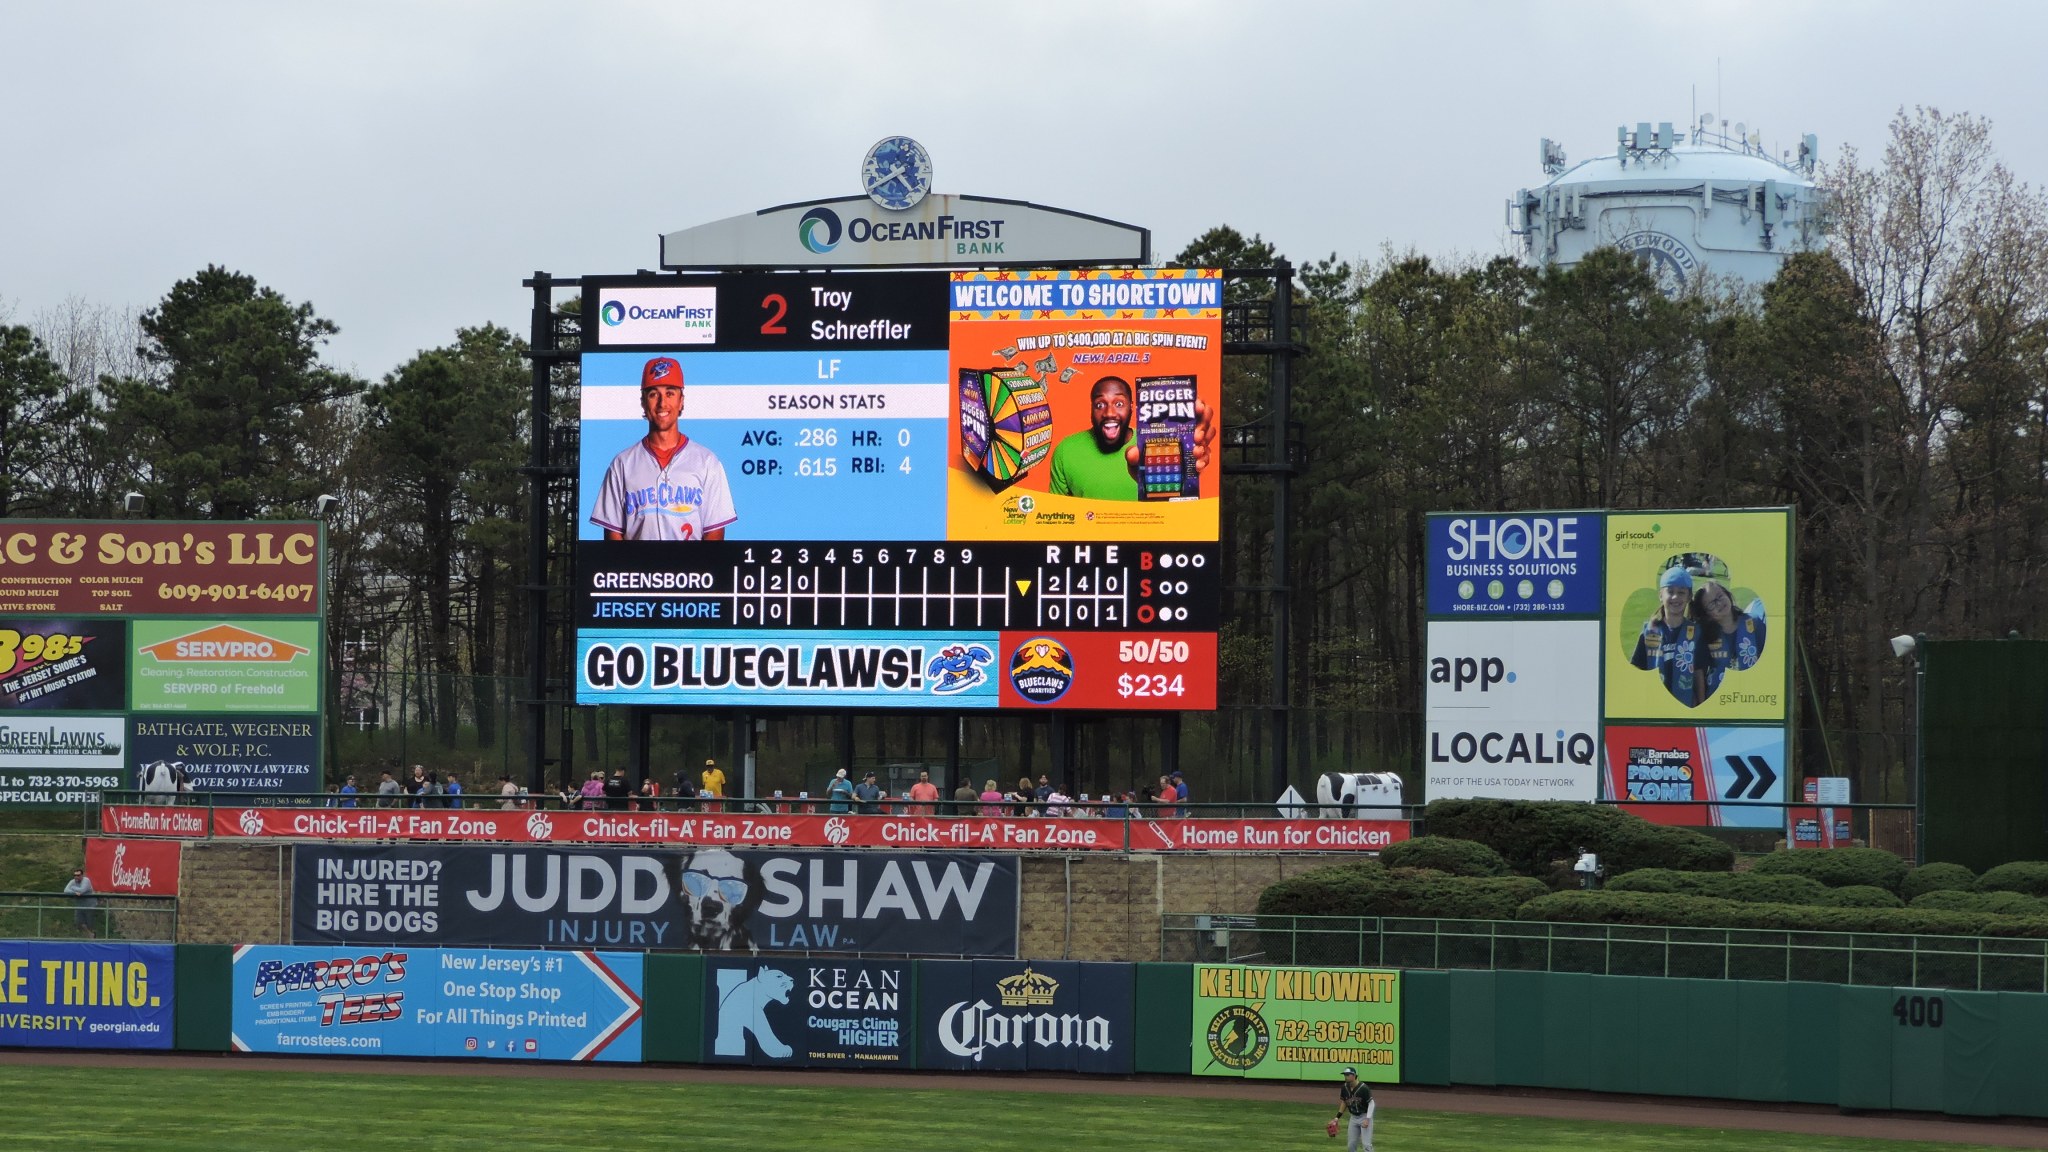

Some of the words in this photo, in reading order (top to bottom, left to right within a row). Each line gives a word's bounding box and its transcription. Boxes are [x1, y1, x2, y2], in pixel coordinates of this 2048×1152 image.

[848, 215, 1004, 243] OCEANFIRST
[957, 242, 1005, 254] BANK
[811, 287, 852, 311] Troy
[955, 283, 1052, 308] WELCOME
[1059, 284, 1085, 307] TO
[1089, 282, 1216, 307] SHORETOWN
[629, 305, 714, 320] OCEANFIRST
[811, 319, 911, 340] Schreffler
[1073, 353, 1104, 363] NEW!
[1106, 353, 1140, 363] APRIL
[1141, 353, 1150, 363] 3
[817, 358, 841, 379] LF
[767, 394, 835, 409] SEASON
[839, 394, 886, 409] STATS
[1139, 388, 1194, 402] BIGGER
[1138, 401, 1196, 423] $PIN
[741, 430, 783, 446] AVG:
[794, 428, 838, 447] .286
[851, 430, 882, 446] HR:
[897, 428, 910, 447] 0
[741, 459, 783, 476] OBP:
[794, 458, 837, 476] .615
[851, 457, 885, 474] RBI:
[899, 456, 912, 475] 4
[1003, 517, 1026, 526] Lottery
[1036, 511, 1075, 521] Anything
[1446, 517, 1578, 561] SHORE
[1615, 530, 1629, 541] girl
[1629, 531, 1655, 539] scouts
[1622, 541, 1630, 549] of
[1631, 541, 1643, 549] the
[1644, 541, 1668, 551] jersey
[1669, 541, 1690, 549] shore
[1140, 552, 1153, 570] B
[1446, 564, 1503, 577] BUSINESS
[1508, 562, 1577, 576] SOLUTIONS
[1, 577, 72, 585] CONSTRUCTION
[79, 576, 110, 584] COLOR
[112, 576, 144, 584] MULCH
[593, 572, 714, 588] GREENSBORO
[743, 575, 755, 590] 0
[770, 575, 782, 590] 2
[797, 575, 809, 590] 0
[1049, 576, 1060, 592] 2
[1077, 576, 1088, 592] 4
[1106, 576, 1118, 592] 0
[27, 589, 59, 597] MULCH
[158, 583, 314, 602] 609-901-6407
[592, 602, 657, 618] JERSEY
[661, 602, 721, 618] SHORE
[743, 603, 754, 618] 0
[770, 603, 781, 618] 0
[1048, 605, 1060, 621] 0
[1076, 605, 1088, 621] 0
[1106, 605, 1118, 621] 1
[1452, 603, 1505, 611] SHORE-BIZ.COM
[1513, 603, 1530, 612] (732)
[1532, 602, 1565, 611] 280-1333
[176, 641, 274, 658] SERVPRO
[1118, 638, 1190, 664] 50/50
[140, 667, 184, 679] Cleaning.
[186, 667, 244, 677] Restoration.
[246, 667, 309, 678] Construction.
[587, 645, 646, 688] GO
[653, 645, 924, 688] BLUECLAWS!
[1429, 657, 1517, 692] app.
[163, 683, 217, 694] SERVPRO
[220, 684, 232, 694] of
[234, 683, 285, 694] Freehold
[1018, 676, 1065, 690] BLUECLAWS
[1117, 672, 1185, 699] $234
[1719, 691, 1777, 706] gsFun.org
[137, 723, 229, 737] BATHGATE,
[231, 723, 313, 737] WEGENER
[176, 743, 189, 757] &
[192, 743, 242, 758] WOLF,
[245, 743, 272, 757] P.C.
[1430, 777, 1451, 786] PART
[1453, 777, 1464, 786] OF
[1467, 777, 1482, 786] THE
[1484, 778, 1501, 786] USA
[1503, 778, 1531, 787] TODAY
[1533, 778, 1575, 787] NETWORK
[1627, 765, 1692, 781] PROMO
[192, 778, 225, 787] OVER
[226, 778, 239, 787] 50
[240, 778, 283, 788] YEARS!
[409, 816, 442, 834] Fan
[447, 816, 497, 835] Zone
[702, 820, 736, 838] Fan
[742, 820, 792, 839] Zone
[1004, 824, 1039, 843] Fan
[1044, 824, 1097, 844] Zone
[1182, 825, 1238, 844] Home
[1244, 825, 1279, 844] Run
[1283, 825, 1309, 844] for
[1315, 825, 1391, 845] Chicken
[318, 858, 442, 881] INJURED?
[466, 853, 671, 914] JUDD
[757, 857, 996, 921] SHAW
[317, 883, 379, 906] HIRE
[385, 884, 439, 907] THE
[316, 910, 359, 931] BIG
[365, 910, 439, 933] DOGS
[547, 919, 670, 944] INJURY
[770, 923, 839, 948] LAW
[842, 937, 857, 945] P.A.
[441, 953, 476, 970] New
[479, 955, 541, 975] Jersey's
[545, 957, 563, 972] #1
[808, 967, 901, 990] KEAN
[1199, 967, 1271, 999] KELLY
[1275, 969, 1396, 1004] KILOWATT
[443, 981, 476, 997] One
[479, 982, 516, 1002] Stop
[520, 983, 561, 1003] Shop
[808, 990, 898, 1011] OCEAN
[259, 1002, 284, 1010] SCREEN
[266, 1009, 306, 1017] EMBROIDERY
[317, 991, 404, 1027] TEES
[1892, 995, 1944, 1028] 400
[89, 1021, 160, 1034] georgian.edu
[255, 1016, 297, 1026] PROMOTIONAL
[298, 1015, 317, 1023] ITEMS
[417, 1008, 443, 1024] For
[446, 1008, 467, 1024] All
[470, 1009, 524, 1029] Things
[527, 1011, 587, 1028] Printed
[808, 1015, 860, 1031] Cougars
[862, 1016, 899, 1031] Climb
[277, 1032, 381, 1048] farrostees.com
[838, 1031, 899, 1047] HIGHER
[938, 999, 1113, 1062] Corona
[1275, 1019, 1394, 1044] 732-367-3030
[1276, 1046, 1394, 1066] KELLYKILOWATT.COM
